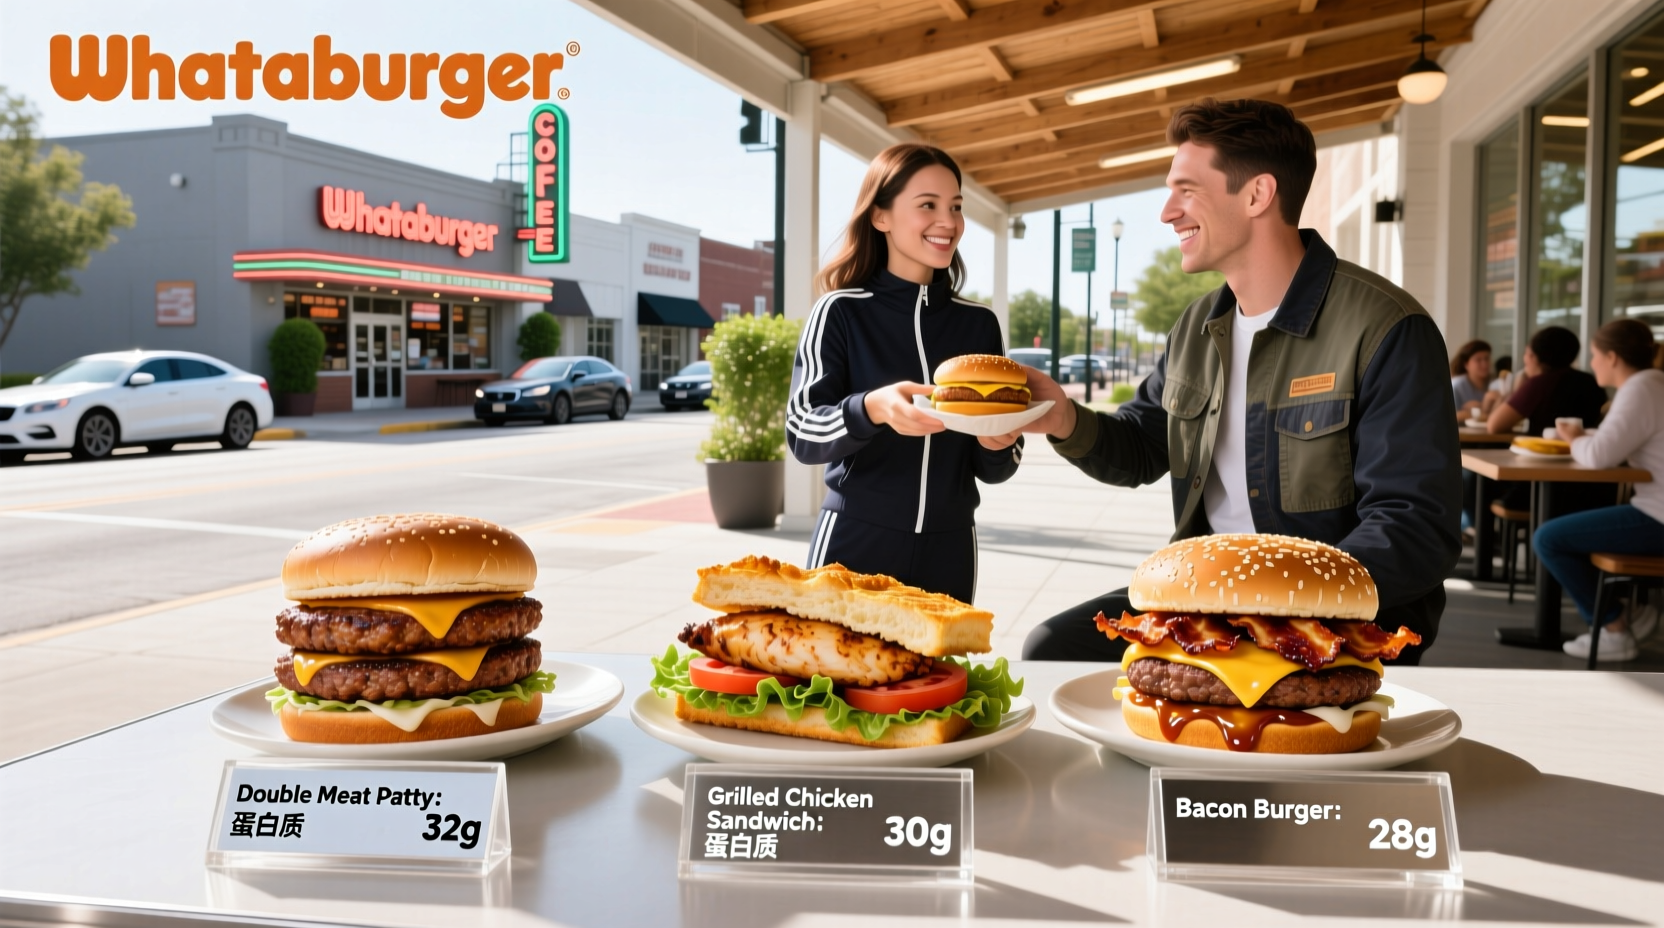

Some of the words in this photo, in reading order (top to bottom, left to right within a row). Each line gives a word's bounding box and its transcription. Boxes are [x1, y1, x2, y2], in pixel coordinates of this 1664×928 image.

[534, 112, 556, 252] COFEE
[322, 185, 499, 258] Whataburger
[236, 784, 312, 803] Double
[317, 785, 371, 805] Meat
[376, 786, 442, 811] Patty:
[708, 786, 779, 806] Grilled
[785, 787, 874, 808] Chicken
[1176, 797, 1247, 818] Bacon
[1254, 798, 1341, 825] Burger:
[230, 811, 305, 838] 蛋白质
[422, 813, 482, 850] 32g
[706, 810, 823, 831] Sandwich:
[884, 815, 952, 856] 30g
[704, 832, 779, 859] 蛋白质
[1368, 818, 1437, 858] 28g
